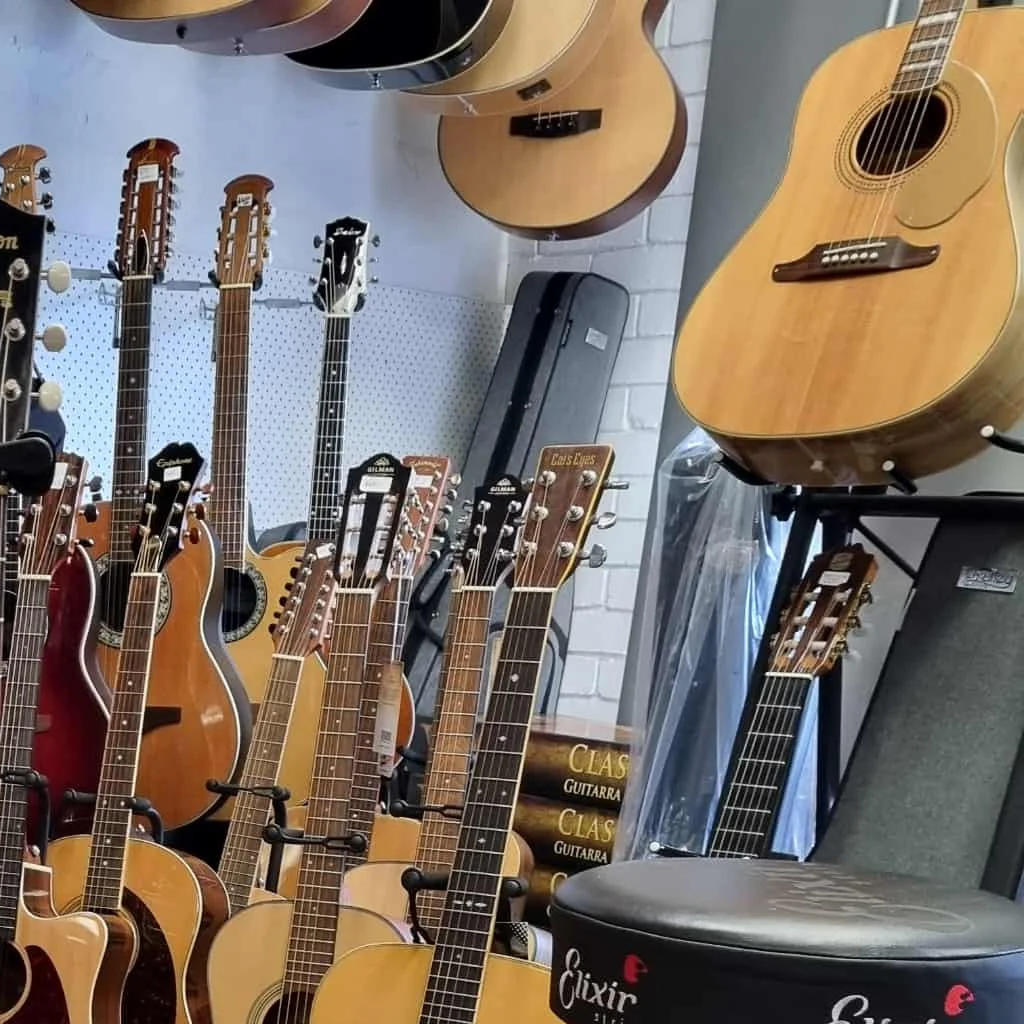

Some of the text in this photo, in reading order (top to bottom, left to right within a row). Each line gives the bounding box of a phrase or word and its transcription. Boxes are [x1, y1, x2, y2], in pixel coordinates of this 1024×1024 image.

[563, 778, 621, 801] GUITARRA
[554, 840, 608, 864] GUITARRA
[559, 947, 638, 1013] Elixir
